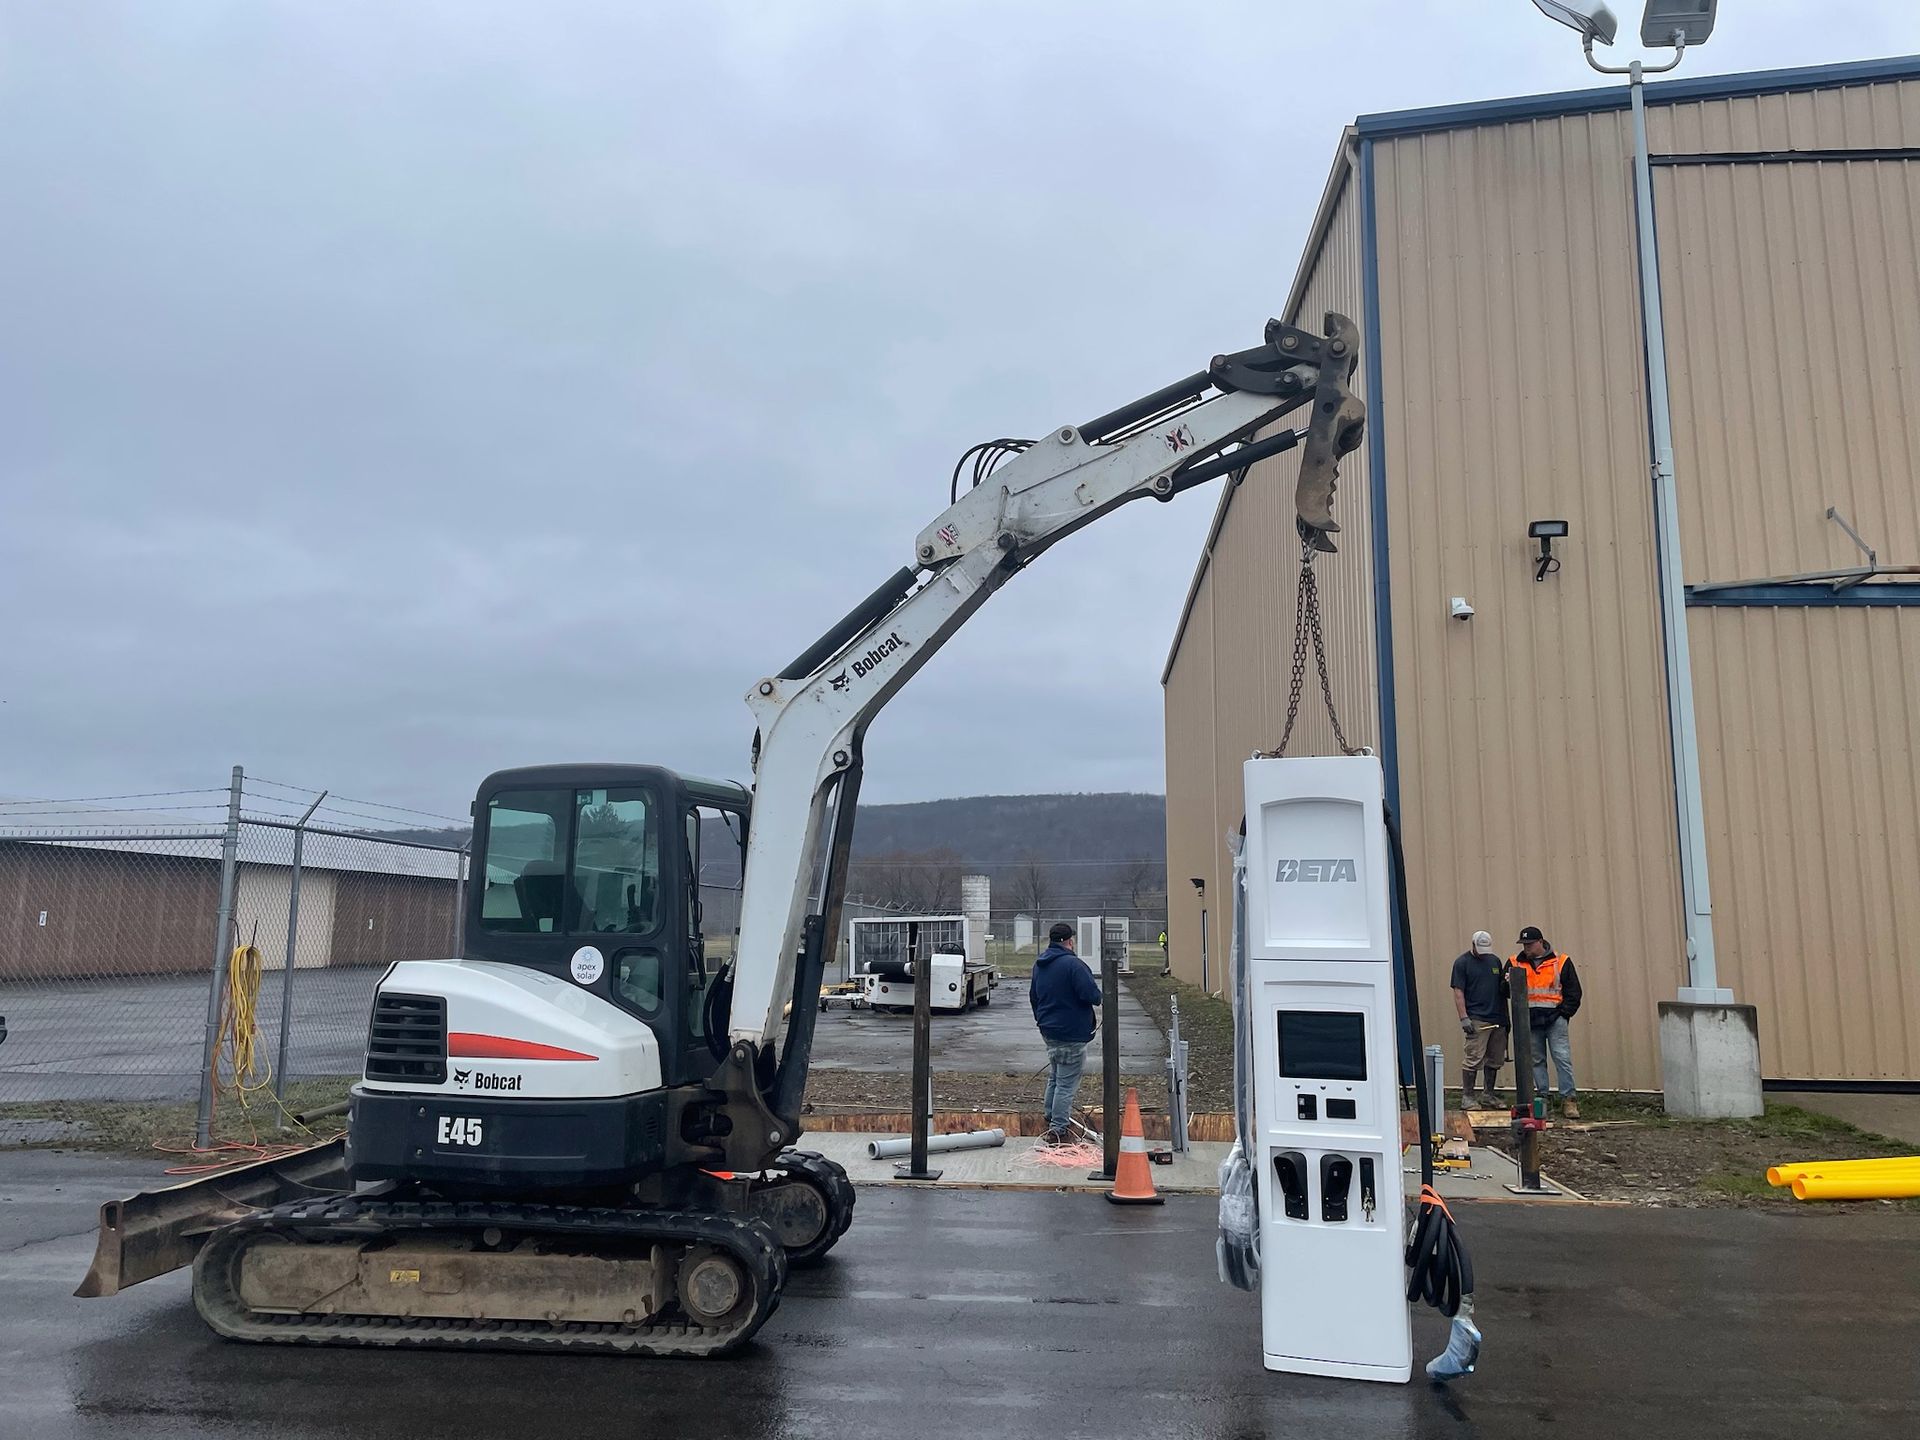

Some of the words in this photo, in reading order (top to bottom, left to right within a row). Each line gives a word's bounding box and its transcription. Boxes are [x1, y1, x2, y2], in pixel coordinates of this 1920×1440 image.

[851, 632, 903, 678] Bobcat
[1275, 859, 1357, 882] BETA
[577, 963, 597, 971] apex
[475, 1072, 522, 1091] Bobcat
[437, 1116, 483, 1146] E45
